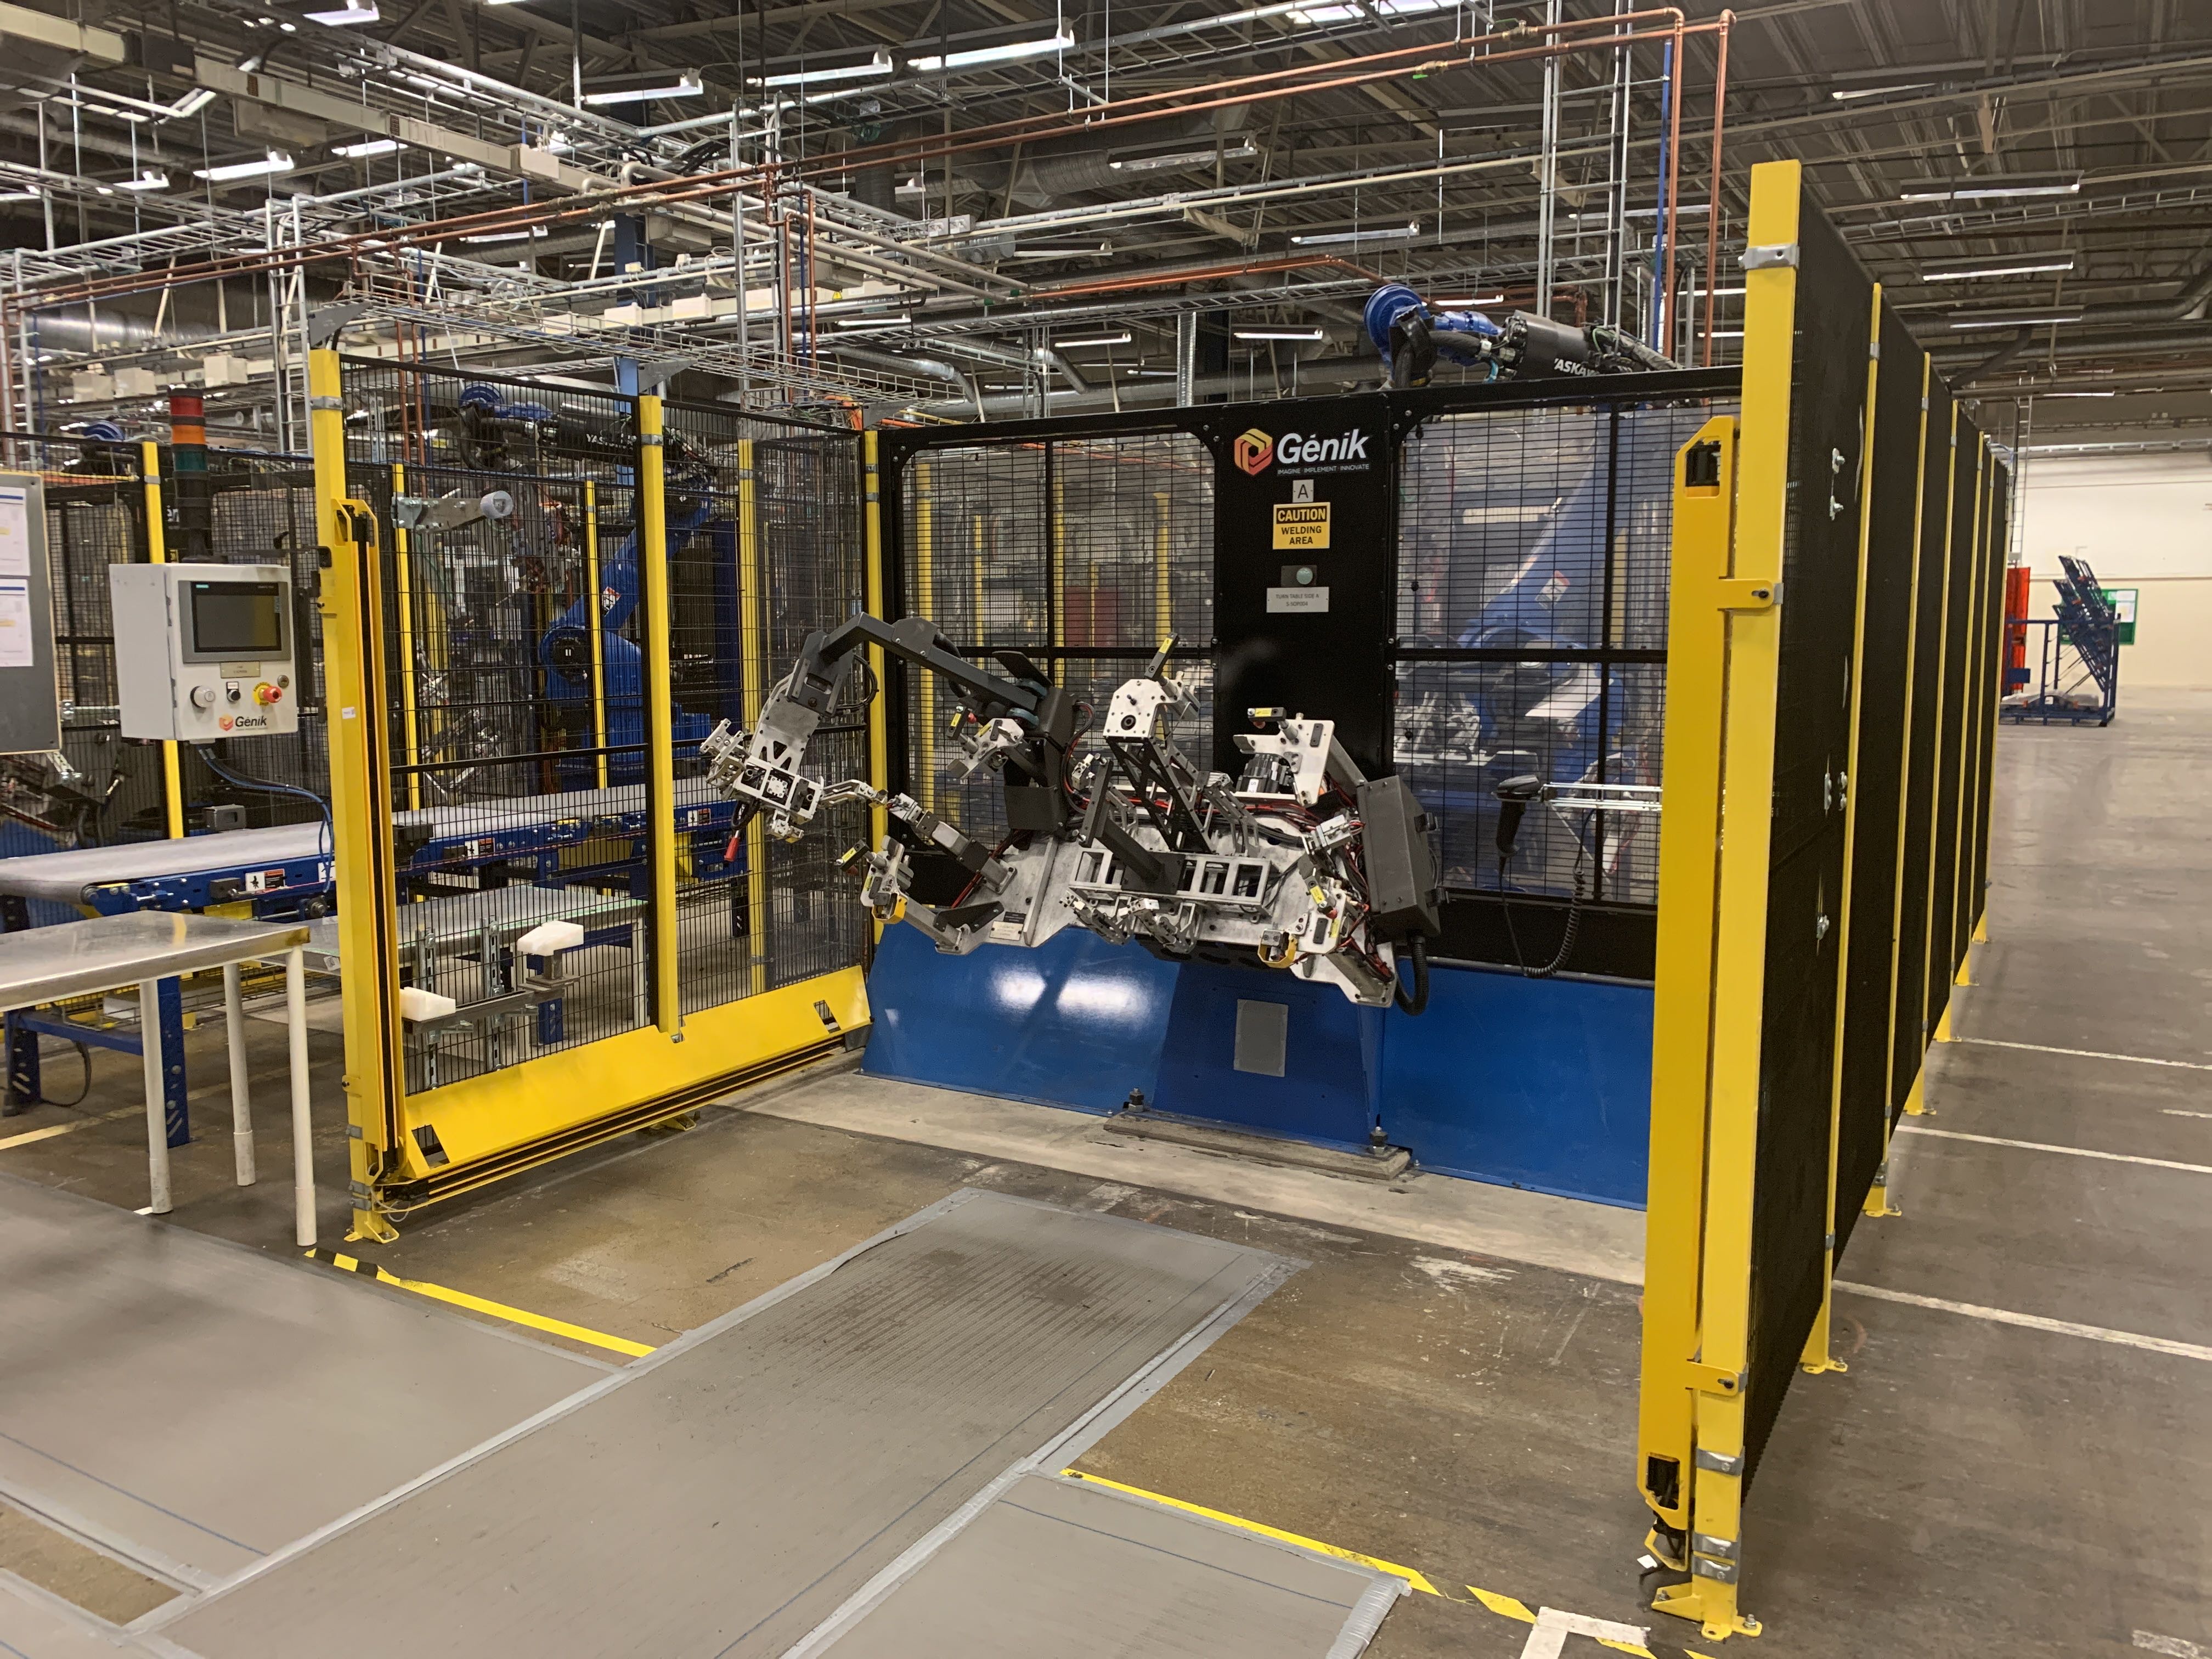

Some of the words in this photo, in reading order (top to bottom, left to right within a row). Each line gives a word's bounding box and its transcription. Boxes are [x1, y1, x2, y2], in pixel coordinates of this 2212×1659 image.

[1277, 428, 1369, 464] Génik
[1297, 484, 1308, 499] A
[1277, 508, 1326, 522] CAUTION
[1281, 526, 1322, 535] WELDING
[1289, 537, 1313, 545] AREA
